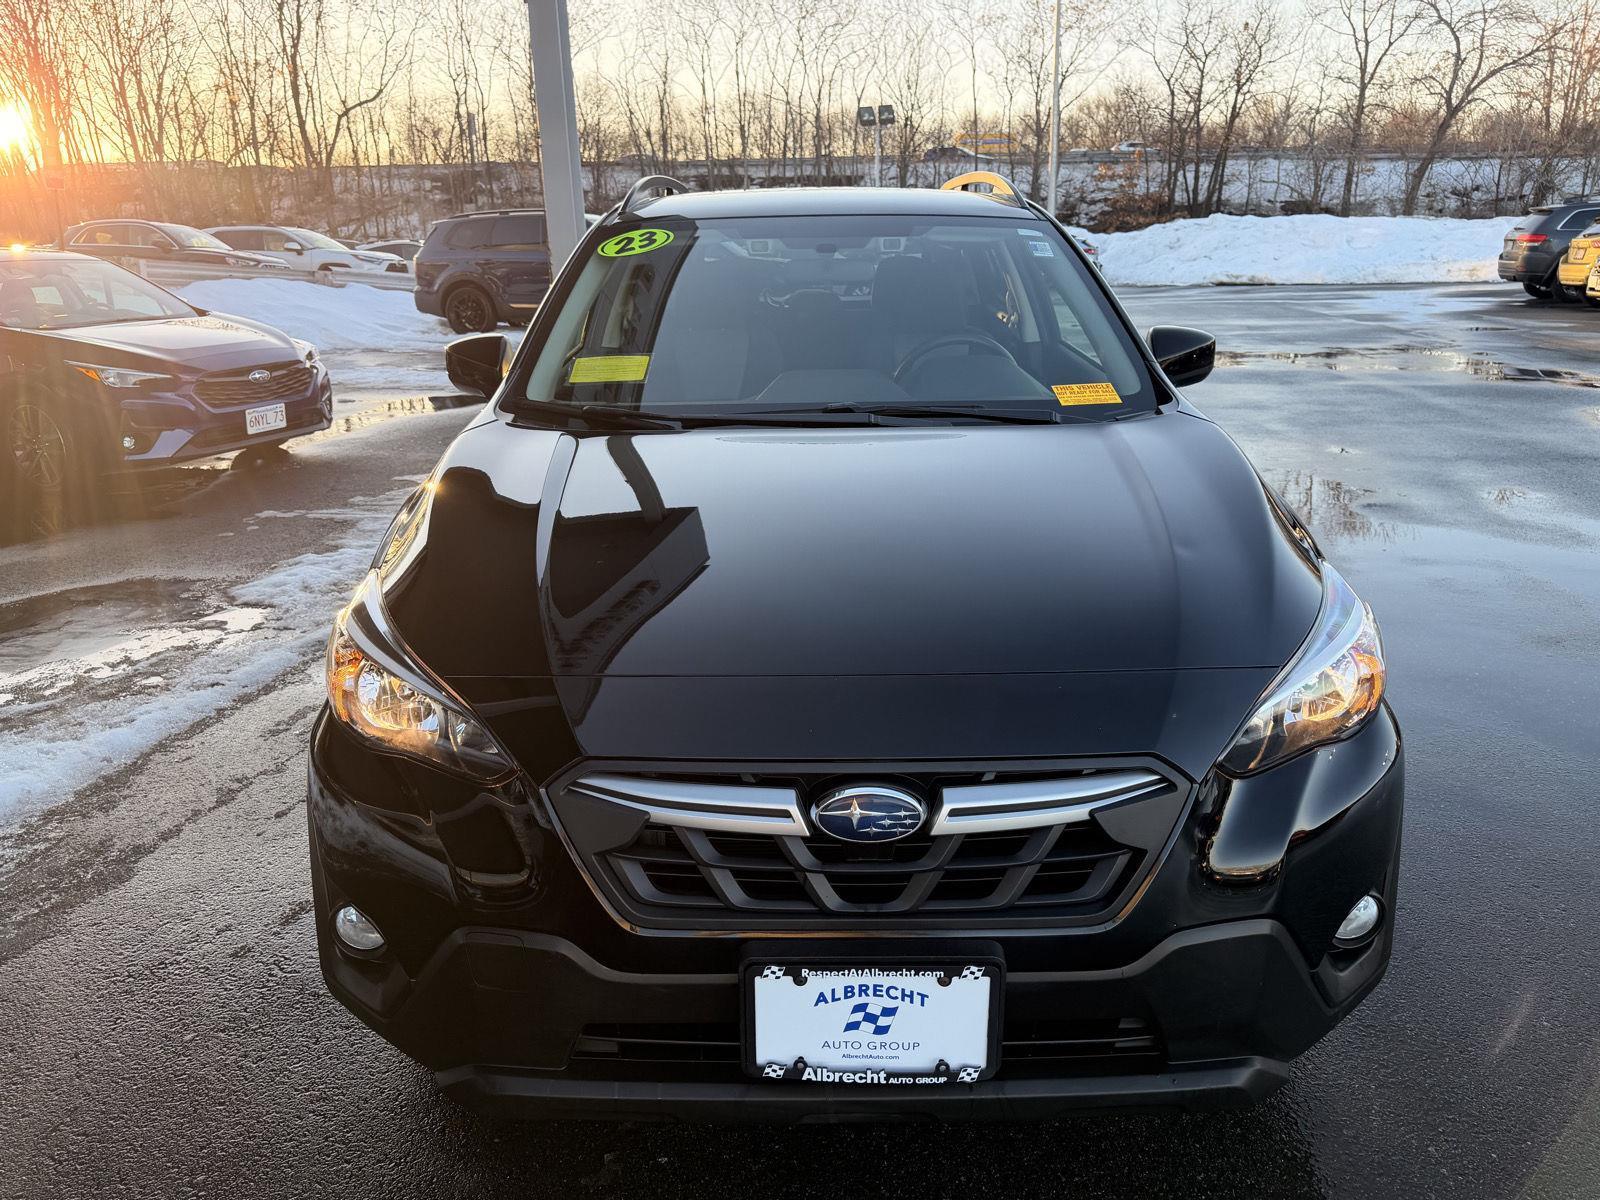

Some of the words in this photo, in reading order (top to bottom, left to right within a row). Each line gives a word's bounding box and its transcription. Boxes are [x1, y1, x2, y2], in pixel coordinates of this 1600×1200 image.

[614, 231, 658, 255] 23
[249, 413, 271, 428] 6NYL
[272, 410, 285, 423] 73
[801, 968, 944, 979] RespectAtAlbrecht.com
[813, 983, 930, 1007] ALBRECHT
[821, 1040, 862, 1051] AUTO
[867, 1041, 920, 1051] GROUP
[841, 1053, 900, 1061] AlbrechtAuto.com
[802, 1066, 887, 1084] Albrecht
[915, 1076, 948, 1084] GROUP
